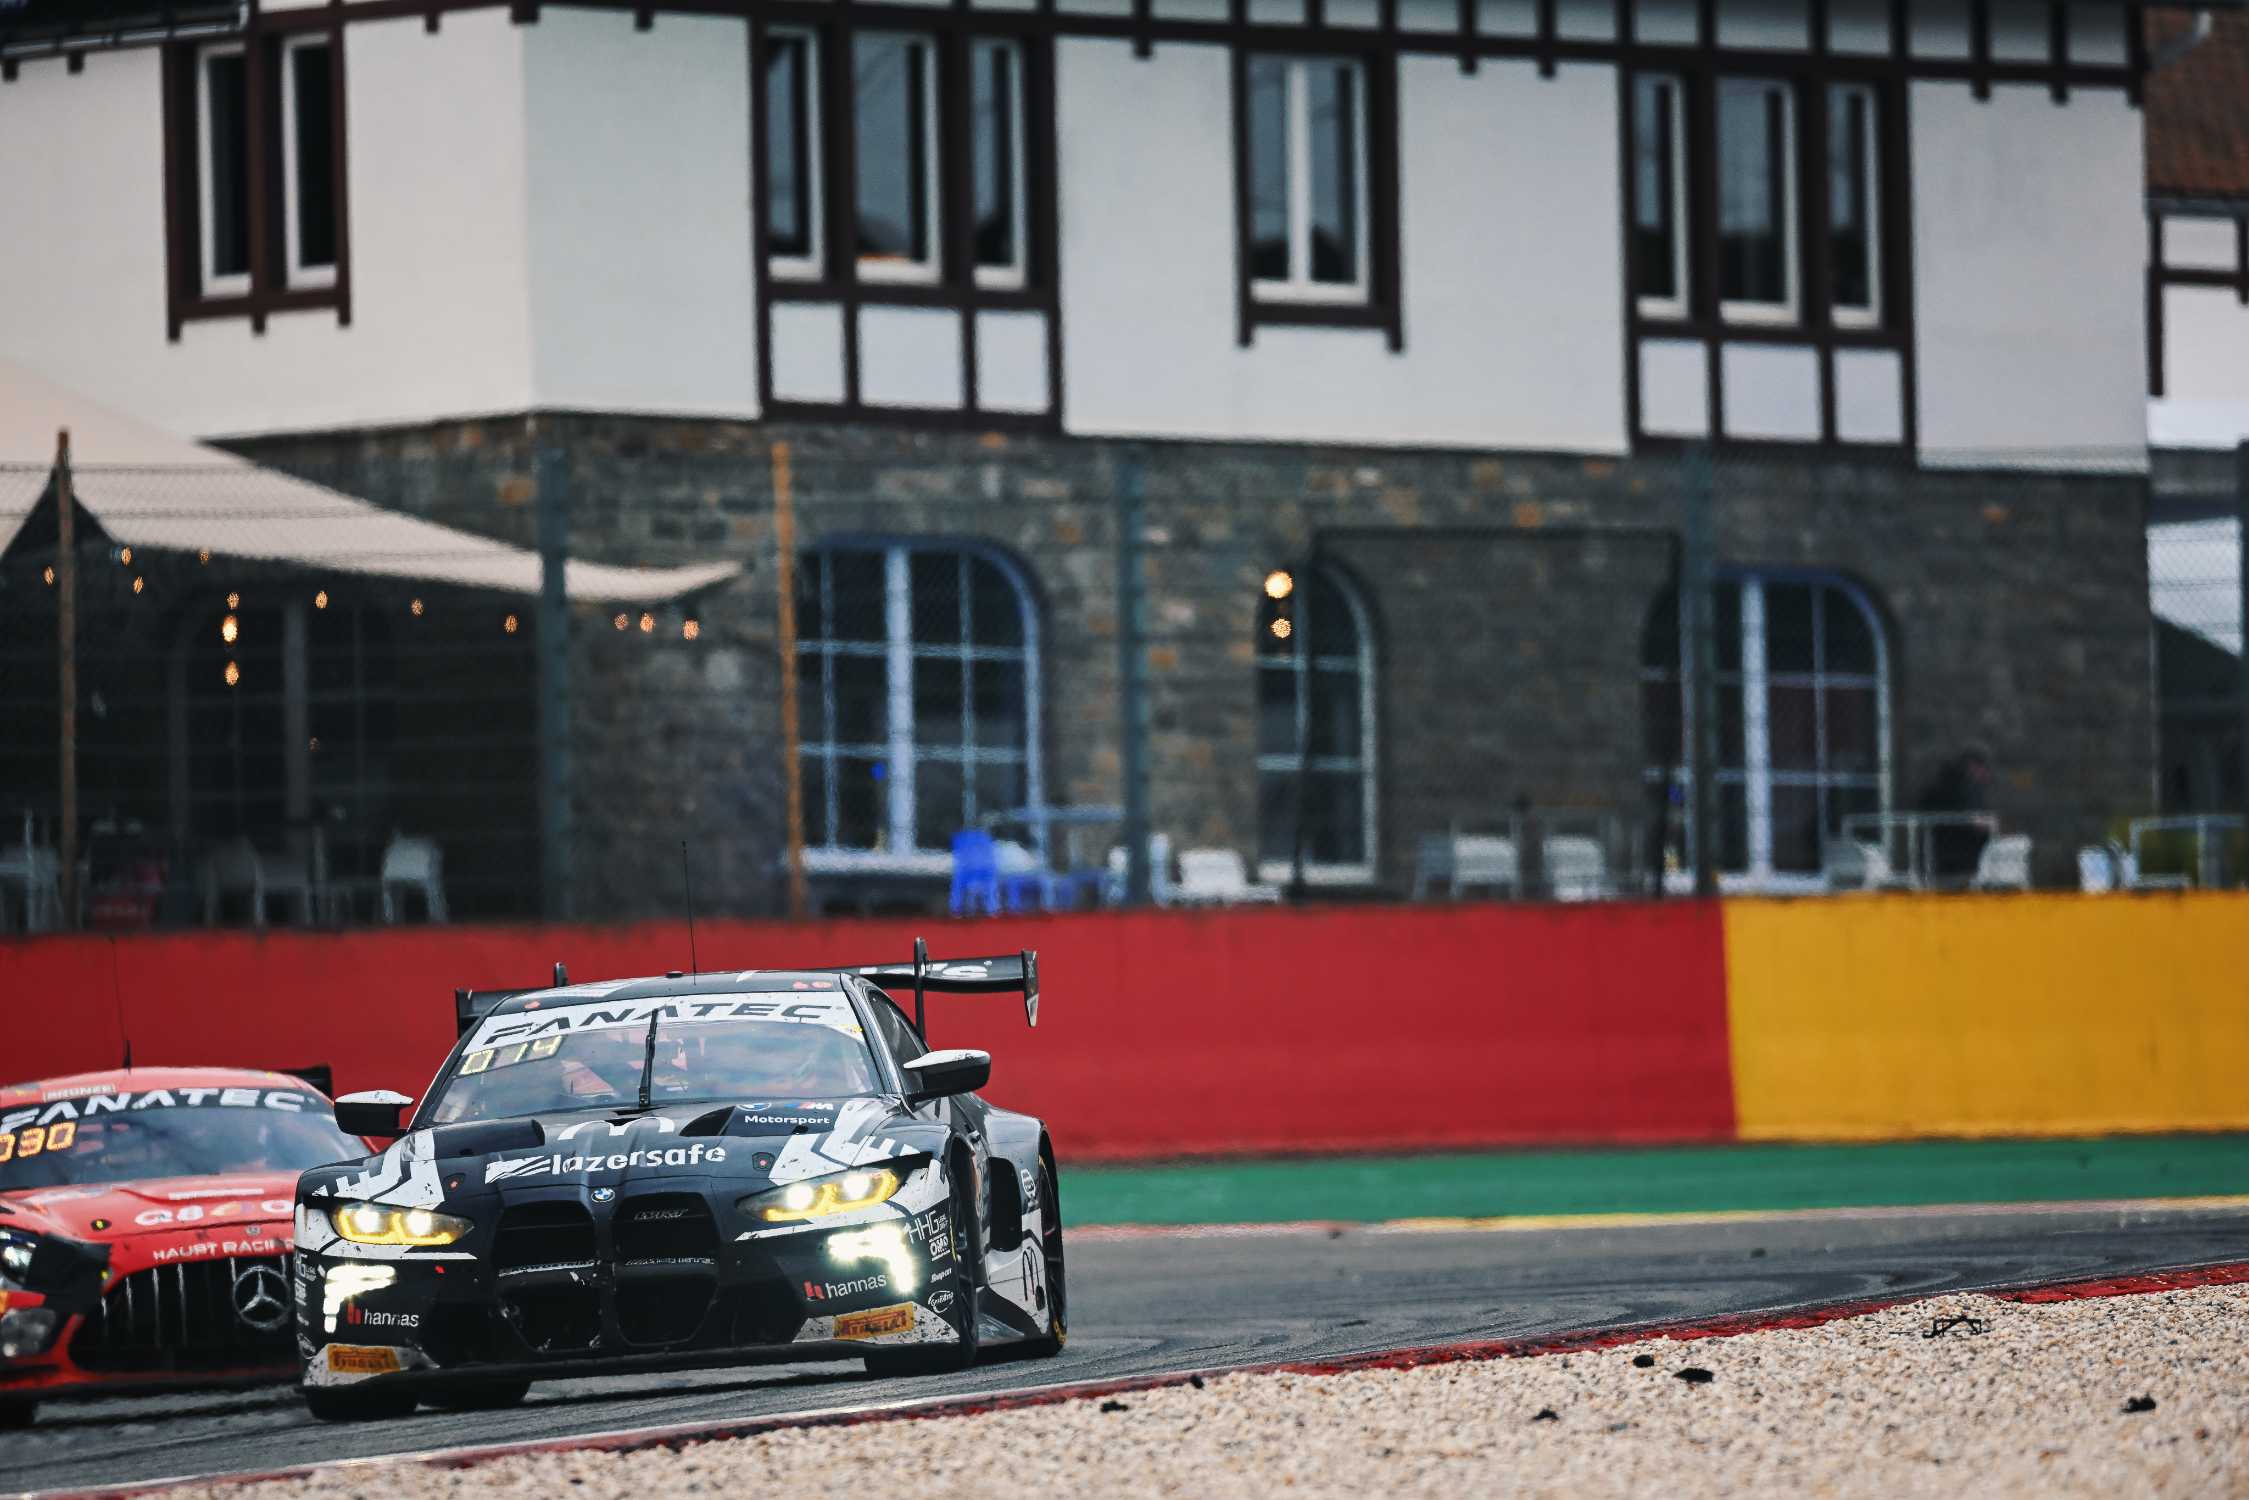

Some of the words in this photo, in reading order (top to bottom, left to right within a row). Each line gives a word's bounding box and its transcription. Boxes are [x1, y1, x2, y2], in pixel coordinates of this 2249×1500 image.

[482, 1002, 832, 1046] FANATEC
[0, 1087, 305, 1134] FANATEC
[744, 1115, 830, 1125] Motorsport
[551, 1143, 727, 1176] lazersafe
[152, 1242, 218, 1261] HAUPT
[826, 1274, 887, 1299] hannas
[364, 1308, 420, 1328] hannas
